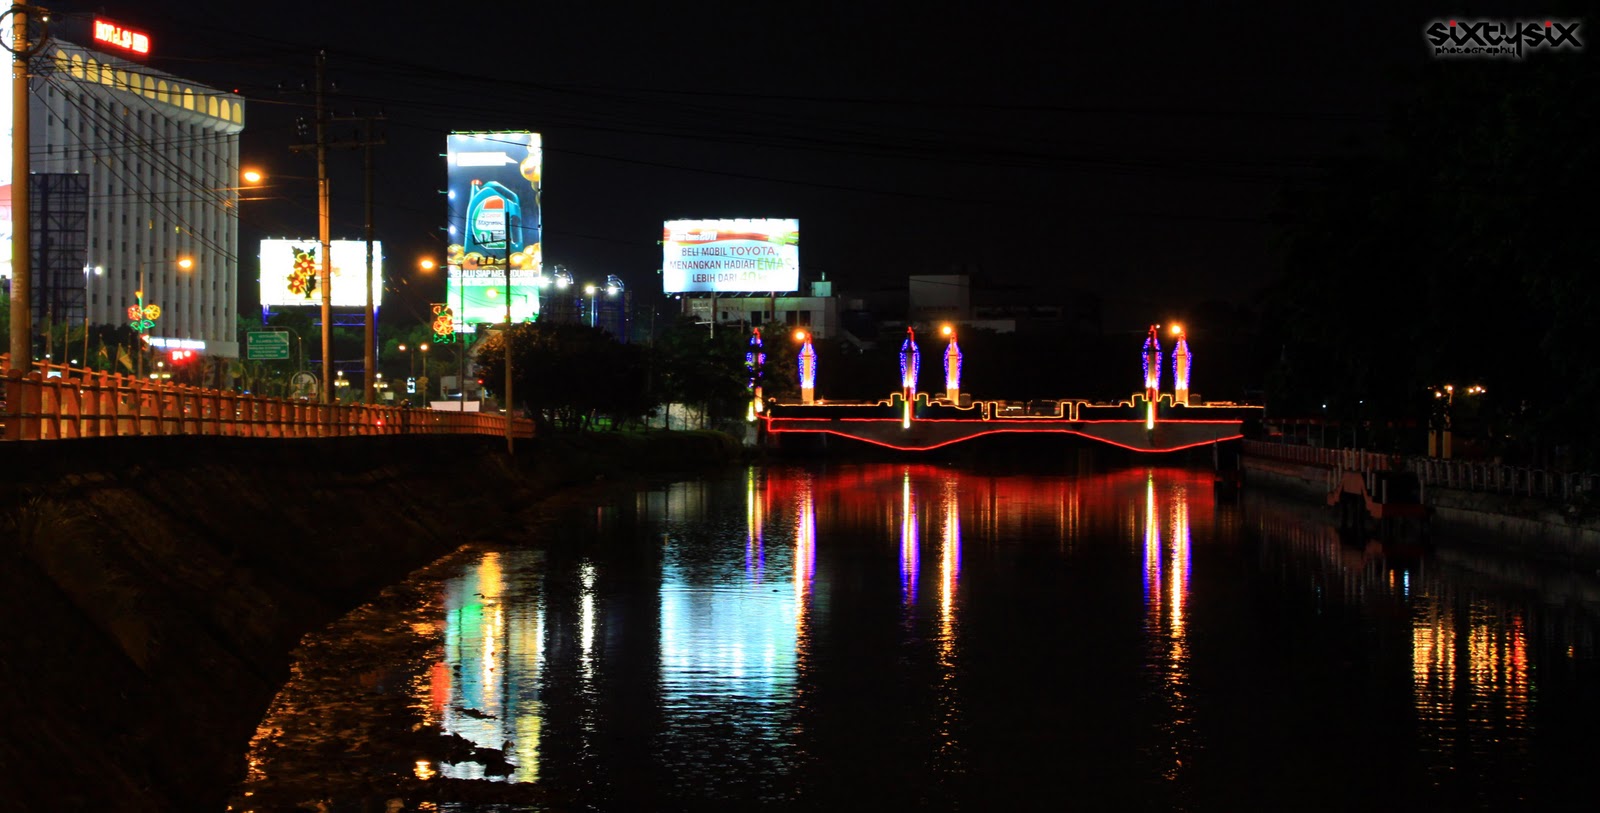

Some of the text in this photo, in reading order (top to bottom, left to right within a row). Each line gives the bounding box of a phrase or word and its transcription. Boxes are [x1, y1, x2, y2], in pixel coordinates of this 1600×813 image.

[681, 247, 699, 256] BELI
[702, 247, 727, 256] MOBIL
[670, 260, 721, 270] MENANGKAN
[724, 260, 755, 269] HADIAH
[476, 269, 490, 278] SIAP
[692, 273, 715, 283] LEBIH
[718, 273, 737, 283] DARI
